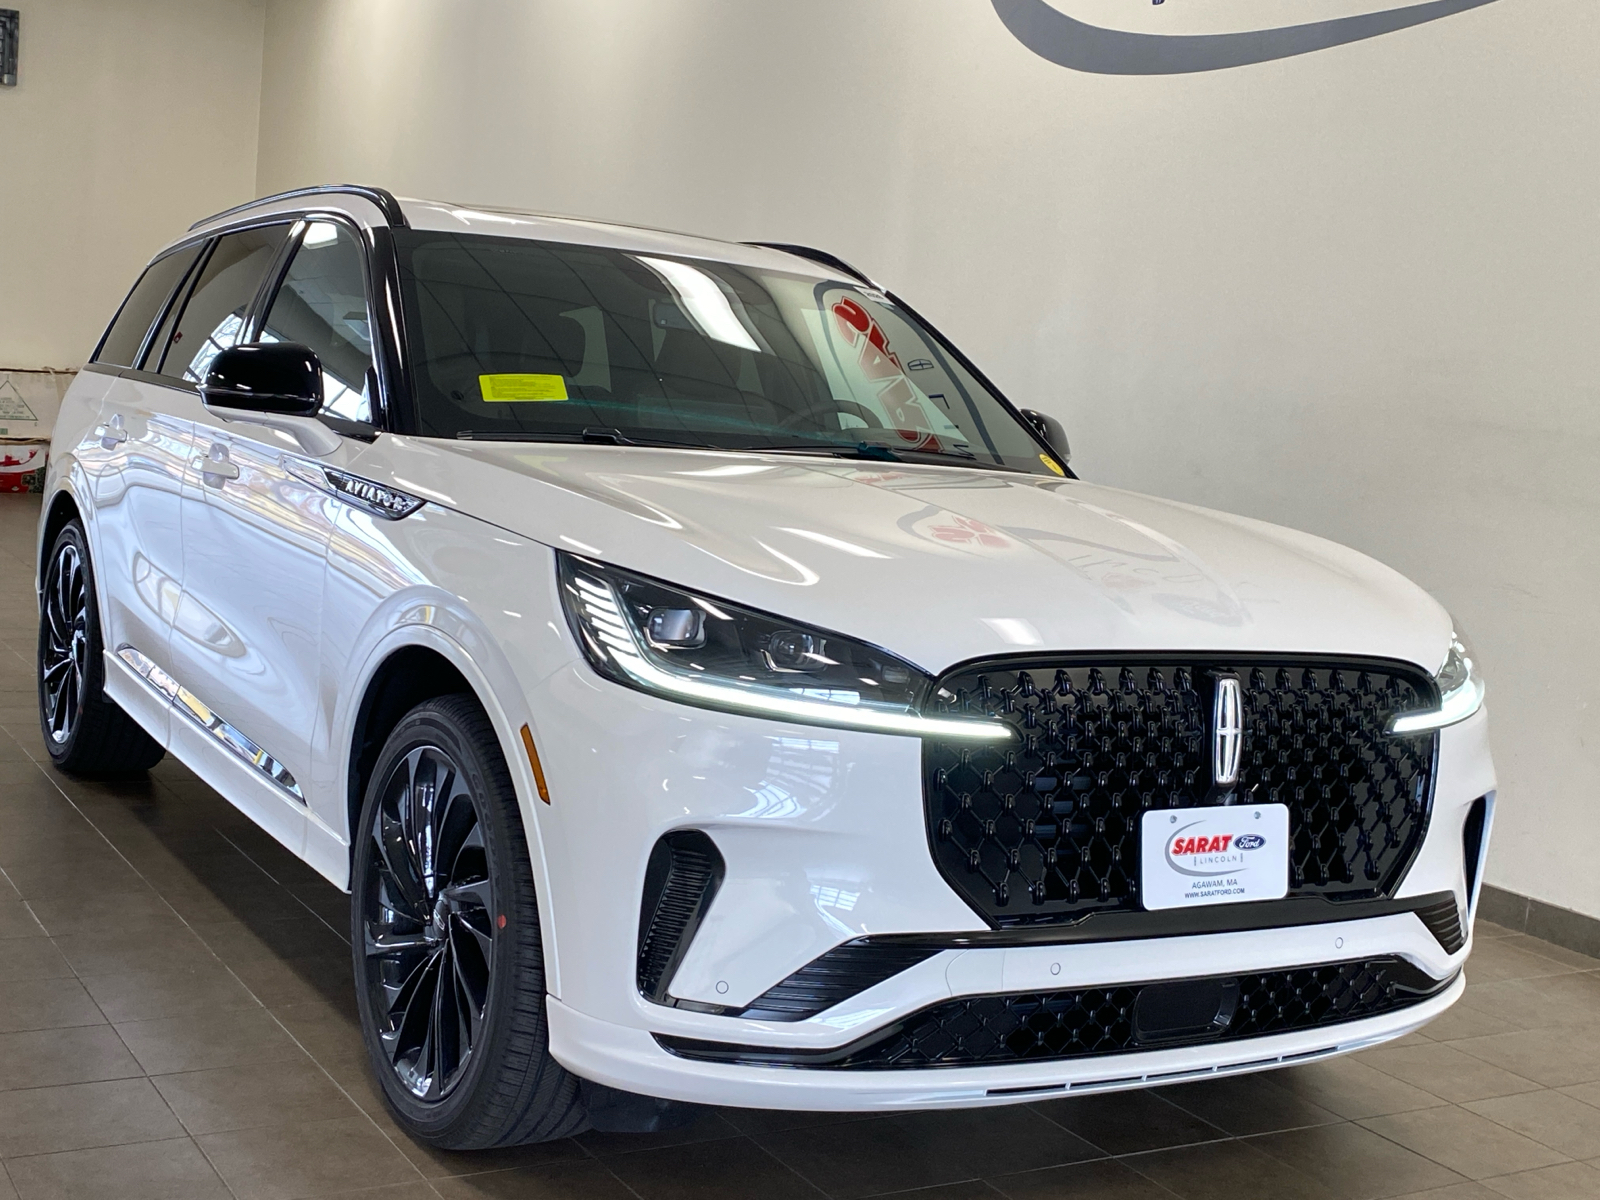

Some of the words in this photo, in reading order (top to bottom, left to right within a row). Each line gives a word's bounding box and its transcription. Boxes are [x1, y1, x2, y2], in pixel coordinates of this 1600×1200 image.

[345, 479, 405, 511] AVIATOR
[1171, 834, 1233, 856] SARAT
[1237, 835, 1262, 849] Ford
[1199, 855, 1238, 865] LINCOLN
[1192, 879, 1225, 889] AGAWAM,
[1185, 888, 1245, 898] WWW.SARATFORD.COM
